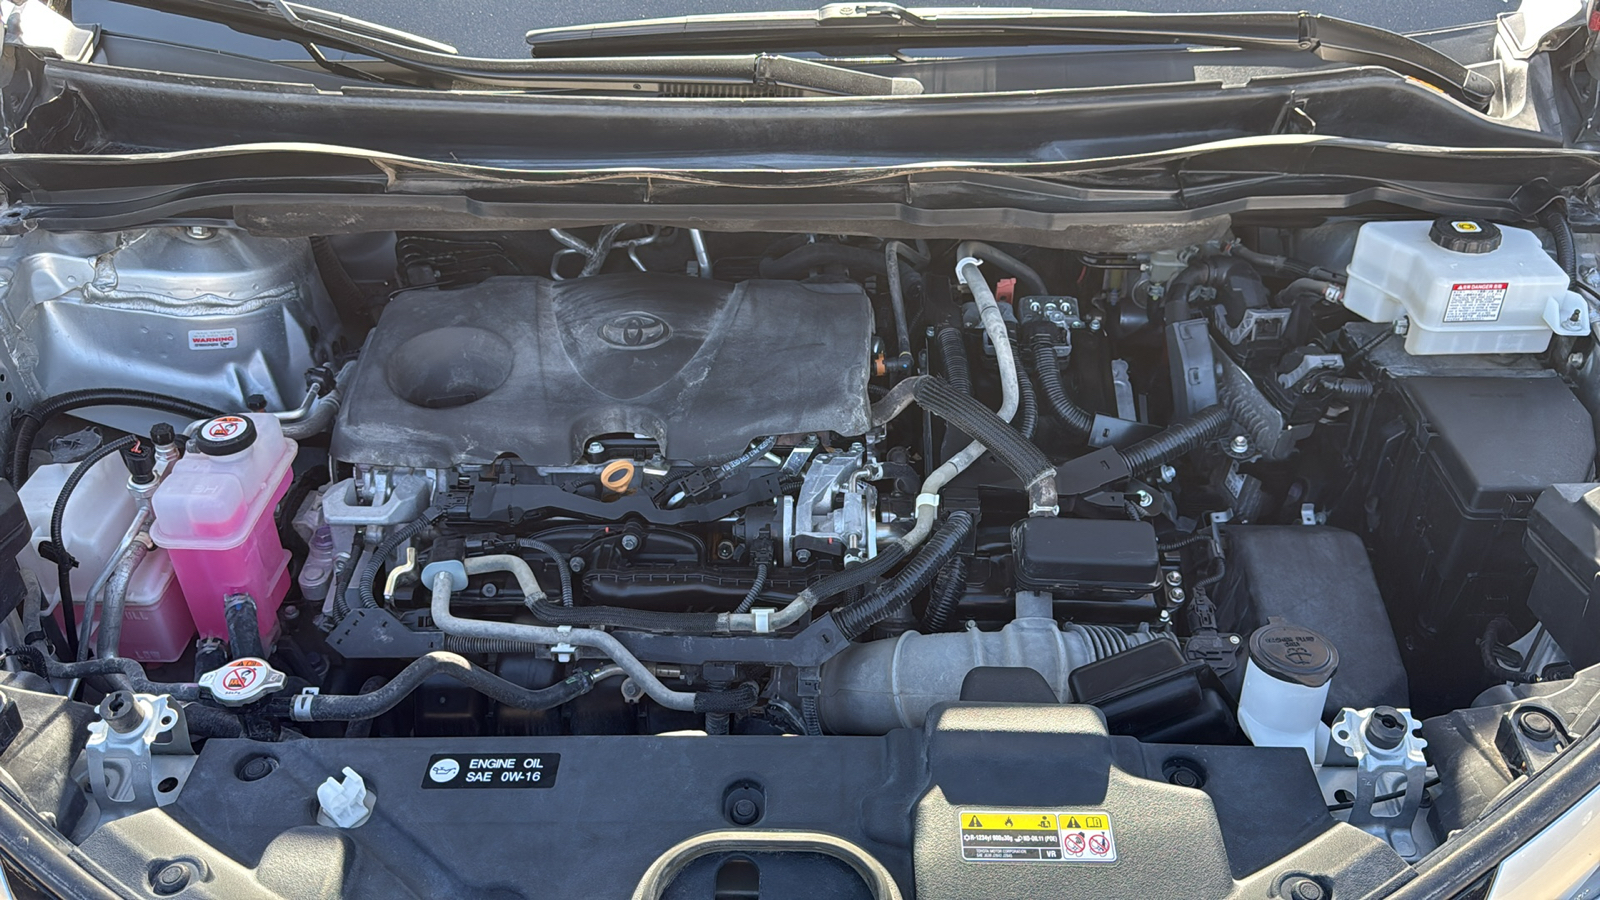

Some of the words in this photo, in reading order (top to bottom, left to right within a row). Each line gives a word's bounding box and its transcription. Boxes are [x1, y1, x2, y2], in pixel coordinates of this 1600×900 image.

[469, 758, 516, 769] ENGINE
[523, 758, 544, 769] OIL
[465, 771, 493, 782] SAE
[500, 771, 541, 782] 0W-16
